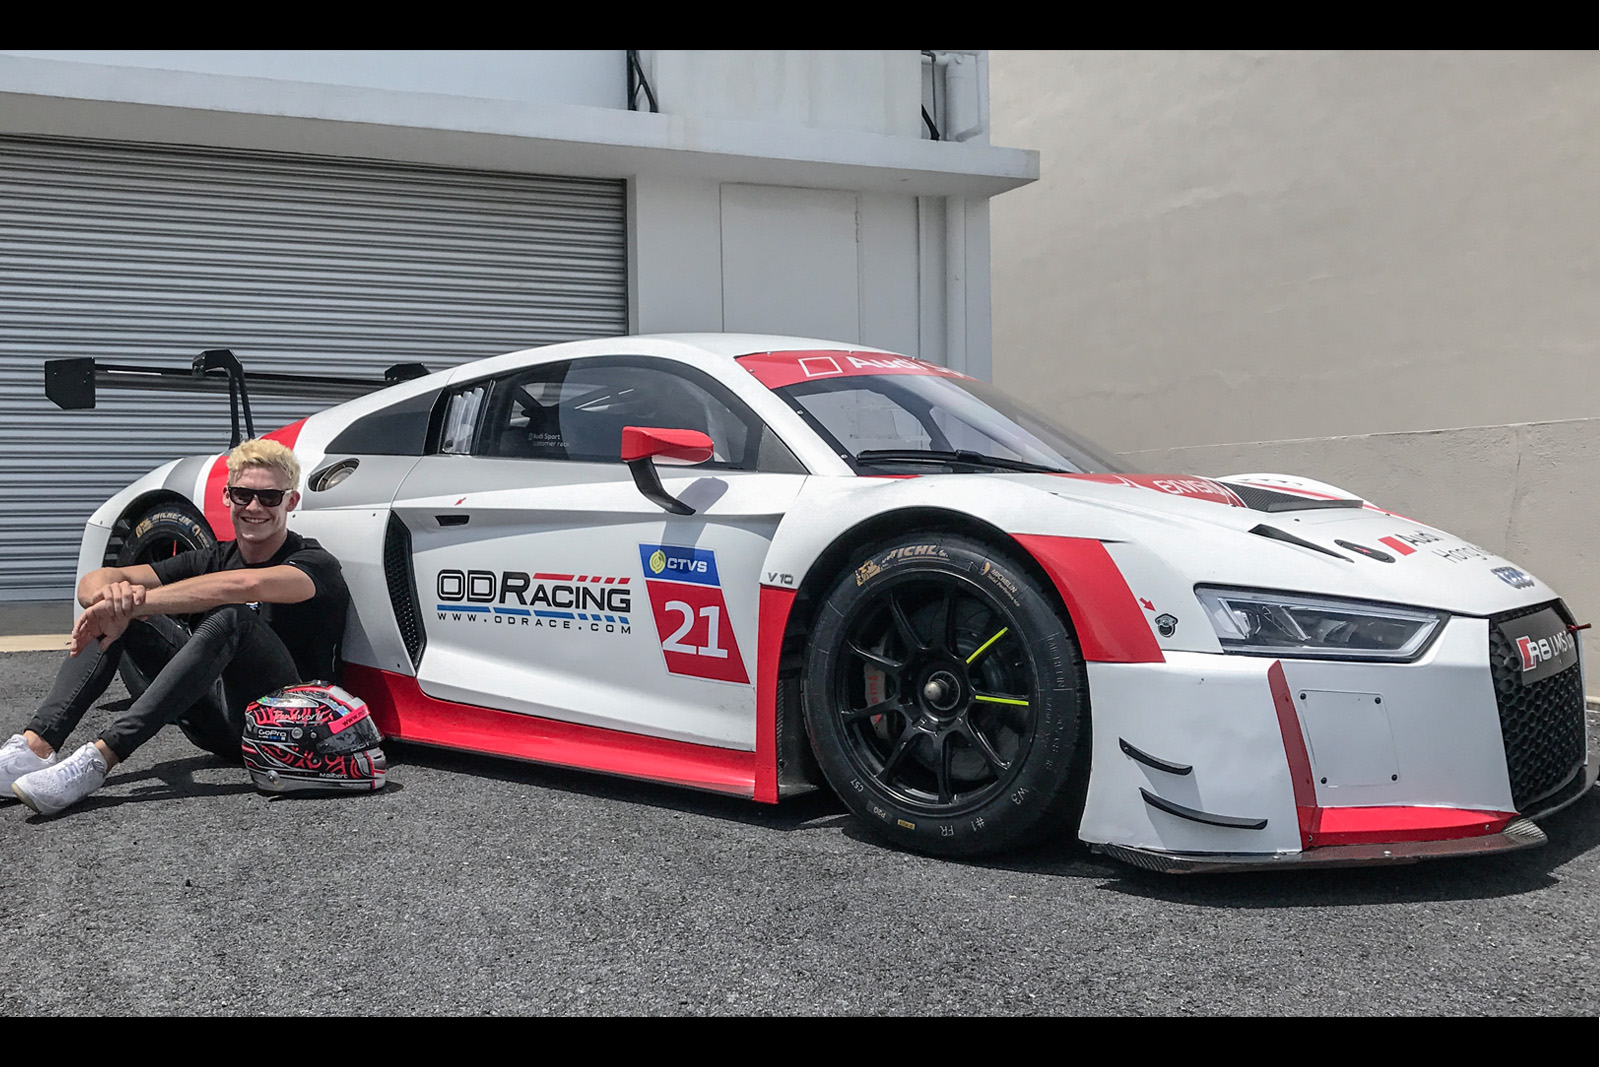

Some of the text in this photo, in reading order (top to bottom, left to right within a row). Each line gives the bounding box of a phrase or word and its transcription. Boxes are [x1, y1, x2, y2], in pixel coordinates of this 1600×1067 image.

[846, 355, 928, 371] Audi
[544, 432, 561, 441] Sport
[667, 557, 708, 573] CTVS
[990, 568, 1018, 593] MICHELIN
[437, 612, 632, 635] WWW.ODRACE.COM
[662, 600, 728, 659] 21
[1526, 640, 1553, 665] R8
[258, 728, 287, 737] GoPro
[939, 816, 986, 837] FR #1
